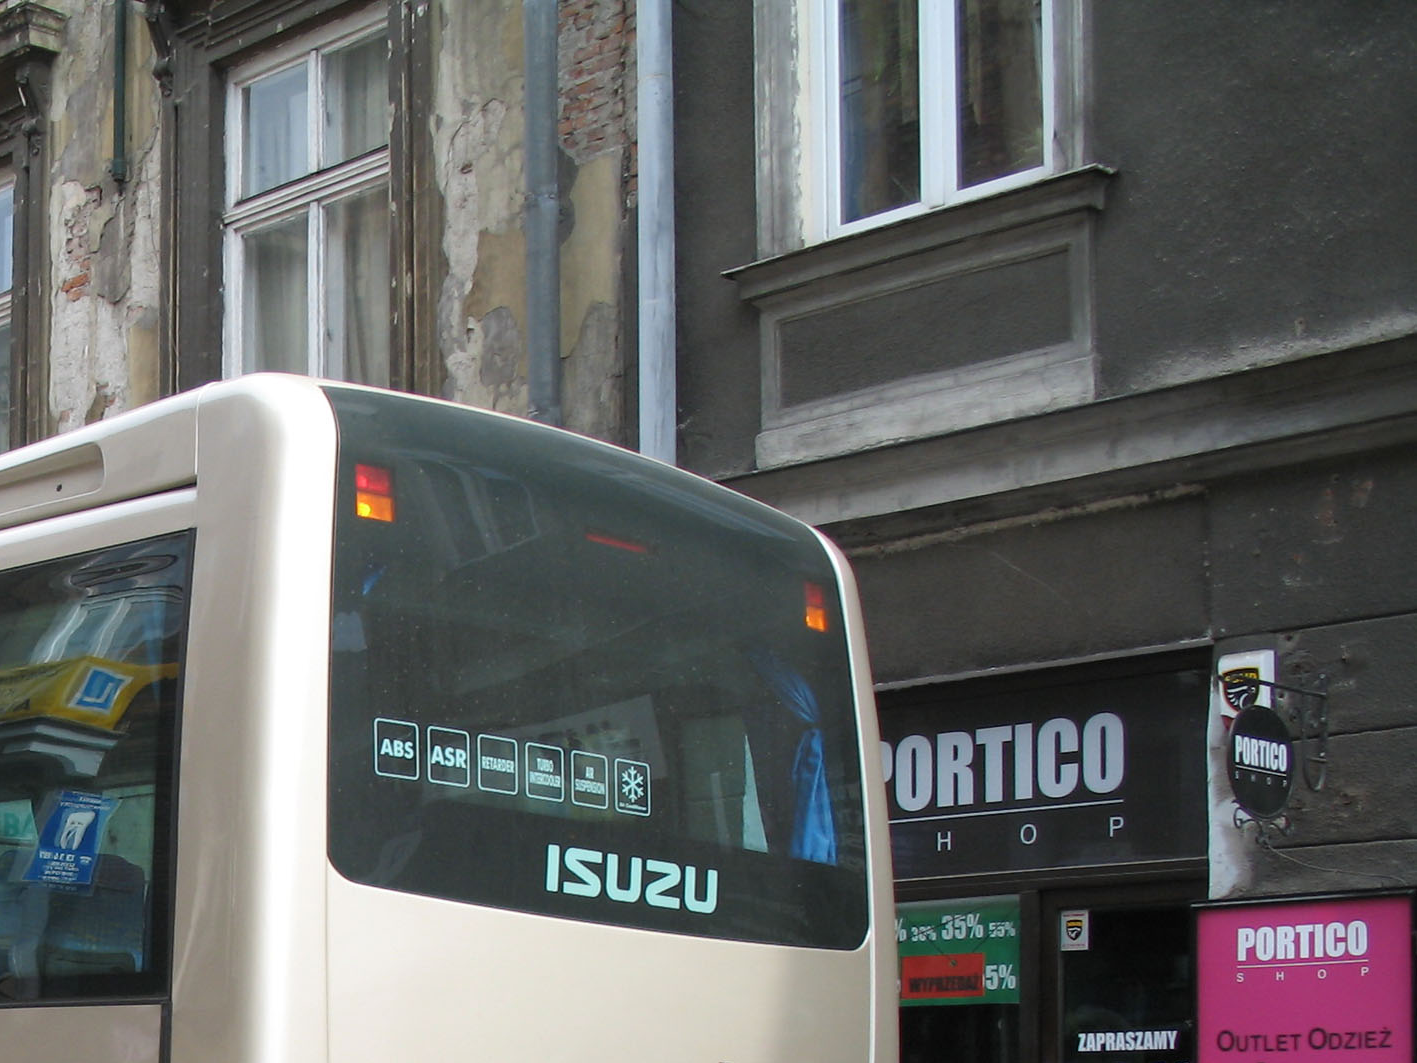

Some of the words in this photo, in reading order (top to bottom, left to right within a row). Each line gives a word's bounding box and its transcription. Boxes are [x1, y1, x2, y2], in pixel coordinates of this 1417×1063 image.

[380, 738, 414, 760] ABS
[431, 745, 467, 768] ASR
[1234, 734, 1288, 772] PORTICO
[481, 755, 515, 774] RETARDER
[545, 843, 719, 914] ISUZU
[941, 913, 984, 941] 35%
[1237, 920, 1369, 962] PORTICO
[983, 963, 1017, 991] 5%
[1236, 967, 1370, 983] SHOP
[1077, 1030, 1178, 1052] ZAPRASZAMY
[1216, 1029, 1302, 1052] OUTLET
[1307, 1026, 1393, 1050] ODZIEŻ
